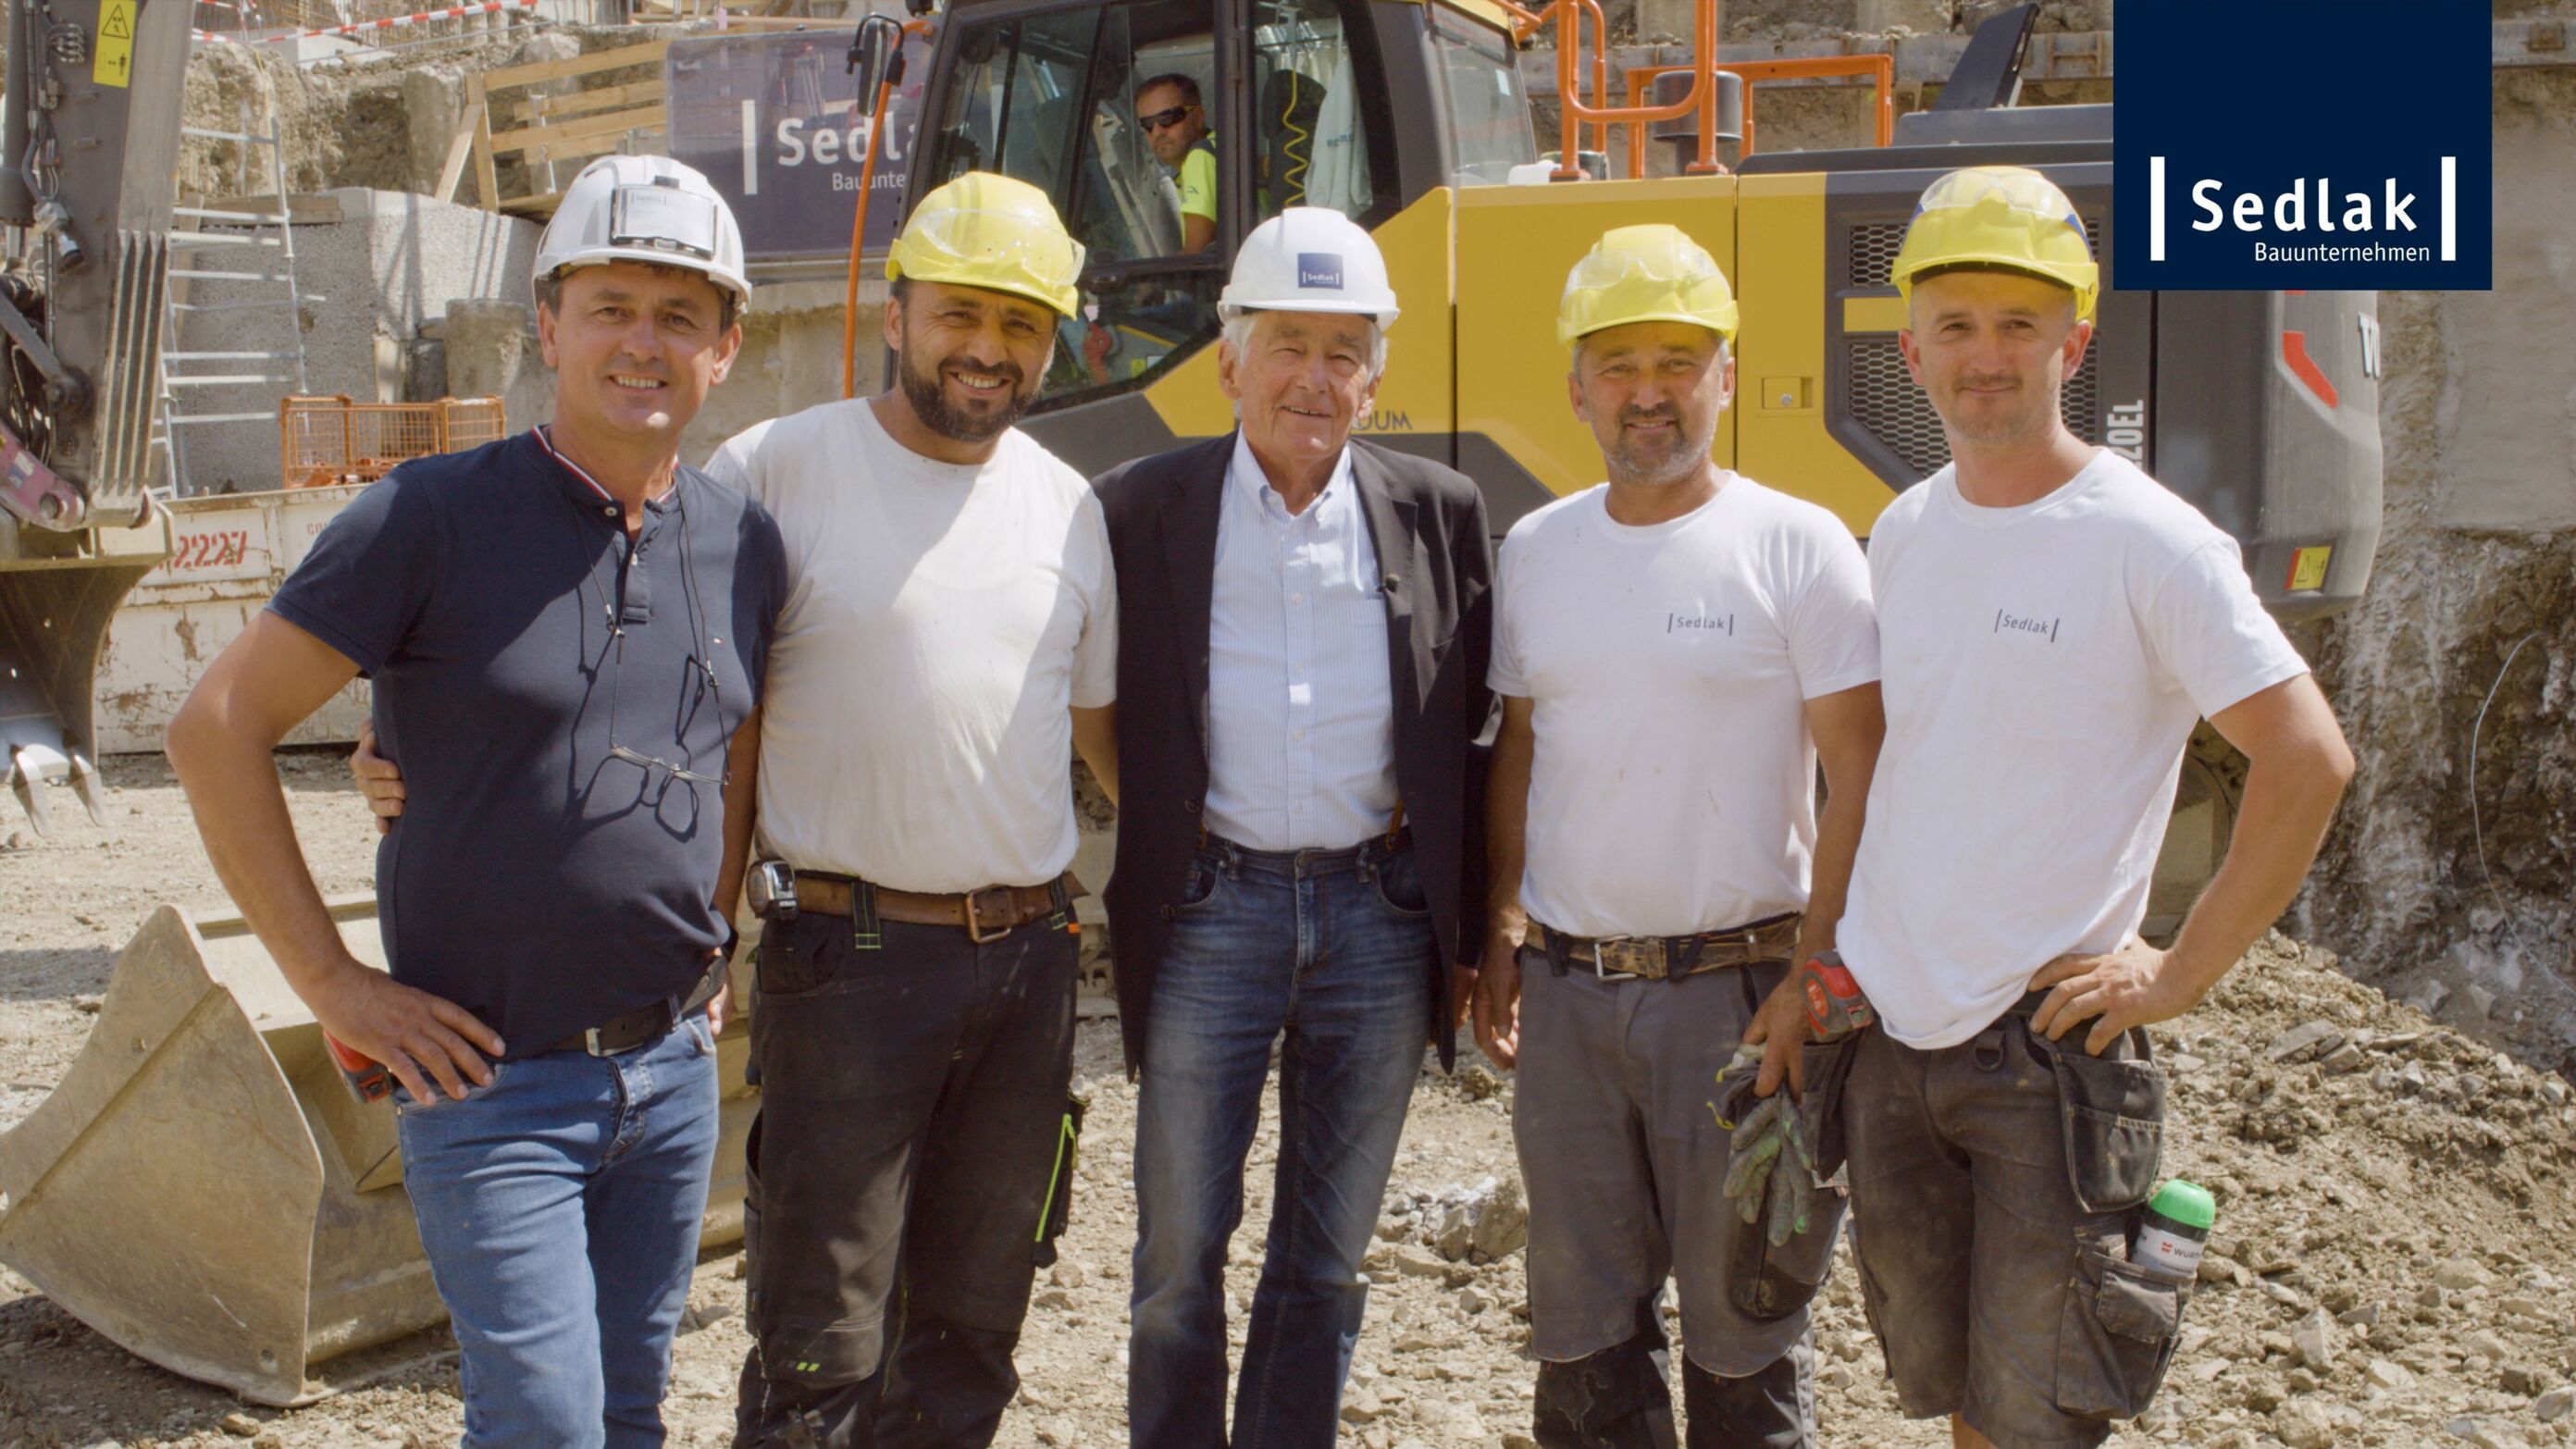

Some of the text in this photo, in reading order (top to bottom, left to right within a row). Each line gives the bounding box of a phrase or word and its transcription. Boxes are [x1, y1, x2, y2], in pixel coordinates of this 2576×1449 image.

[2107, 399, 2144, 473] 20EL
[159, 530, 248, 570] 2227
[1676, 616, 1725, 629] Sedlak
[2002, 614, 2049, 635] Sedlak
